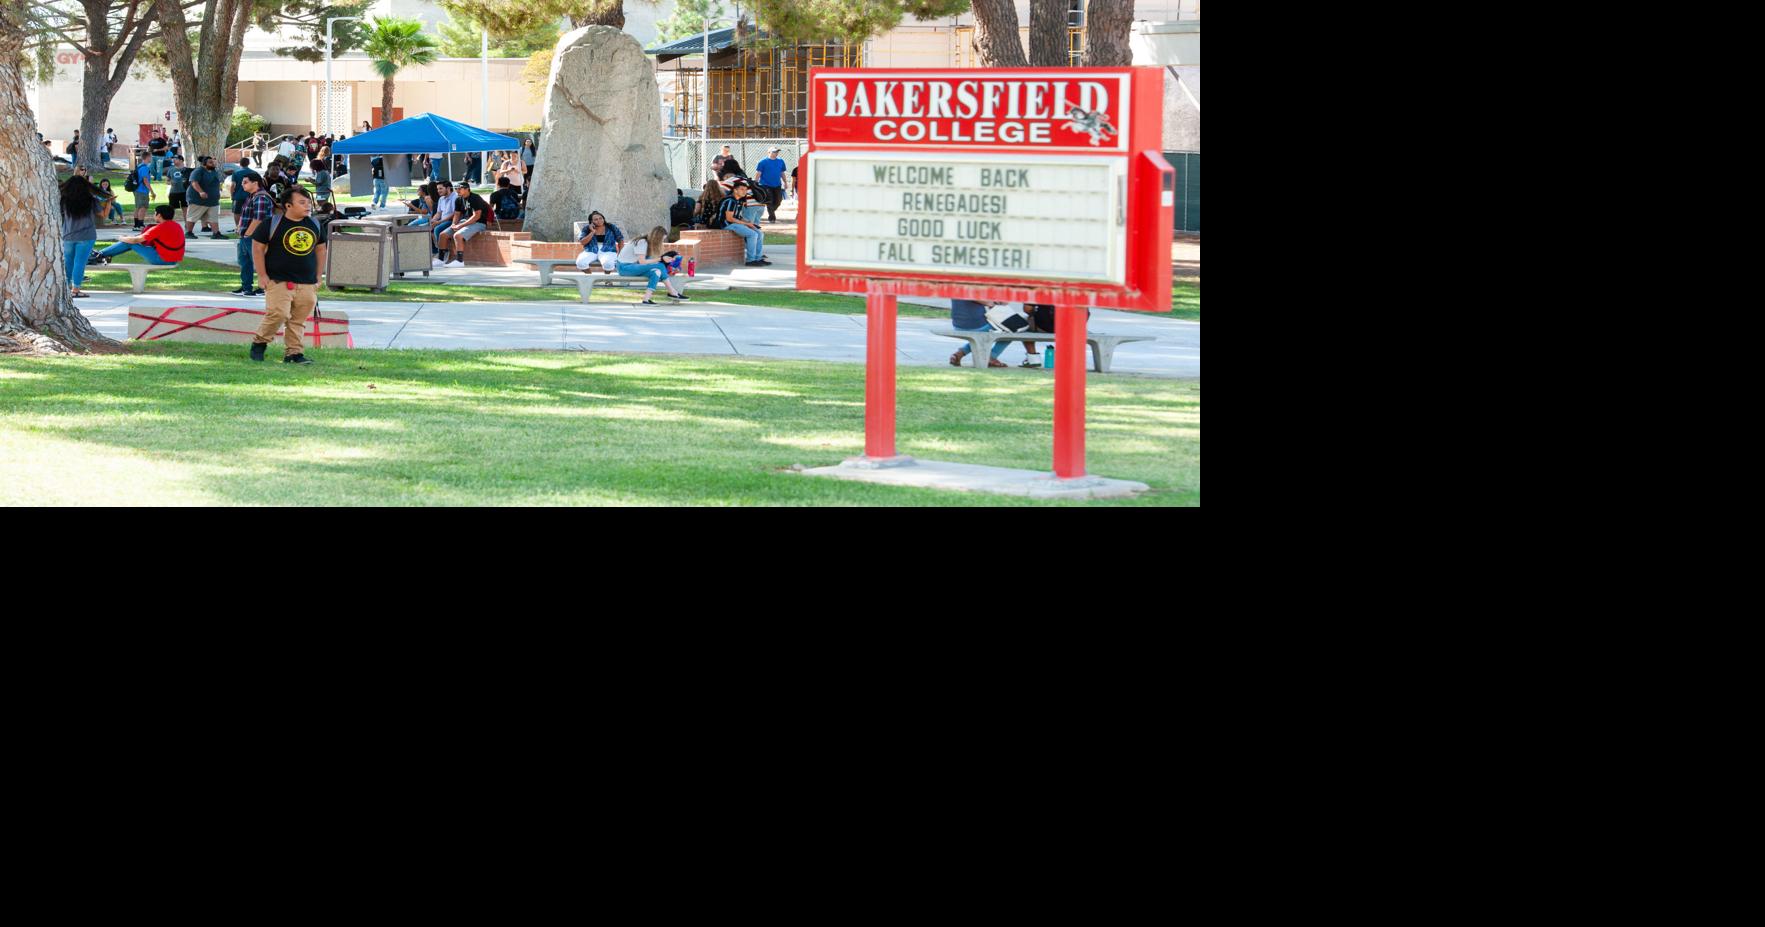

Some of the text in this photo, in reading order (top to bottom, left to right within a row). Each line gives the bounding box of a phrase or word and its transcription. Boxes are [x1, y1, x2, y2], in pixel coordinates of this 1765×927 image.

[824, 81, 1109, 120] BAKERSFIELD
[873, 120, 1052, 143] COLLEGE
[873, 165, 1030, 188] WELCOME BACK
[902, 192, 1007, 214] RENEGADES!
[898, 218, 1001, 240] GOOD LUCK
[878, 242, 1030, 269] FALL SEMESTER!
